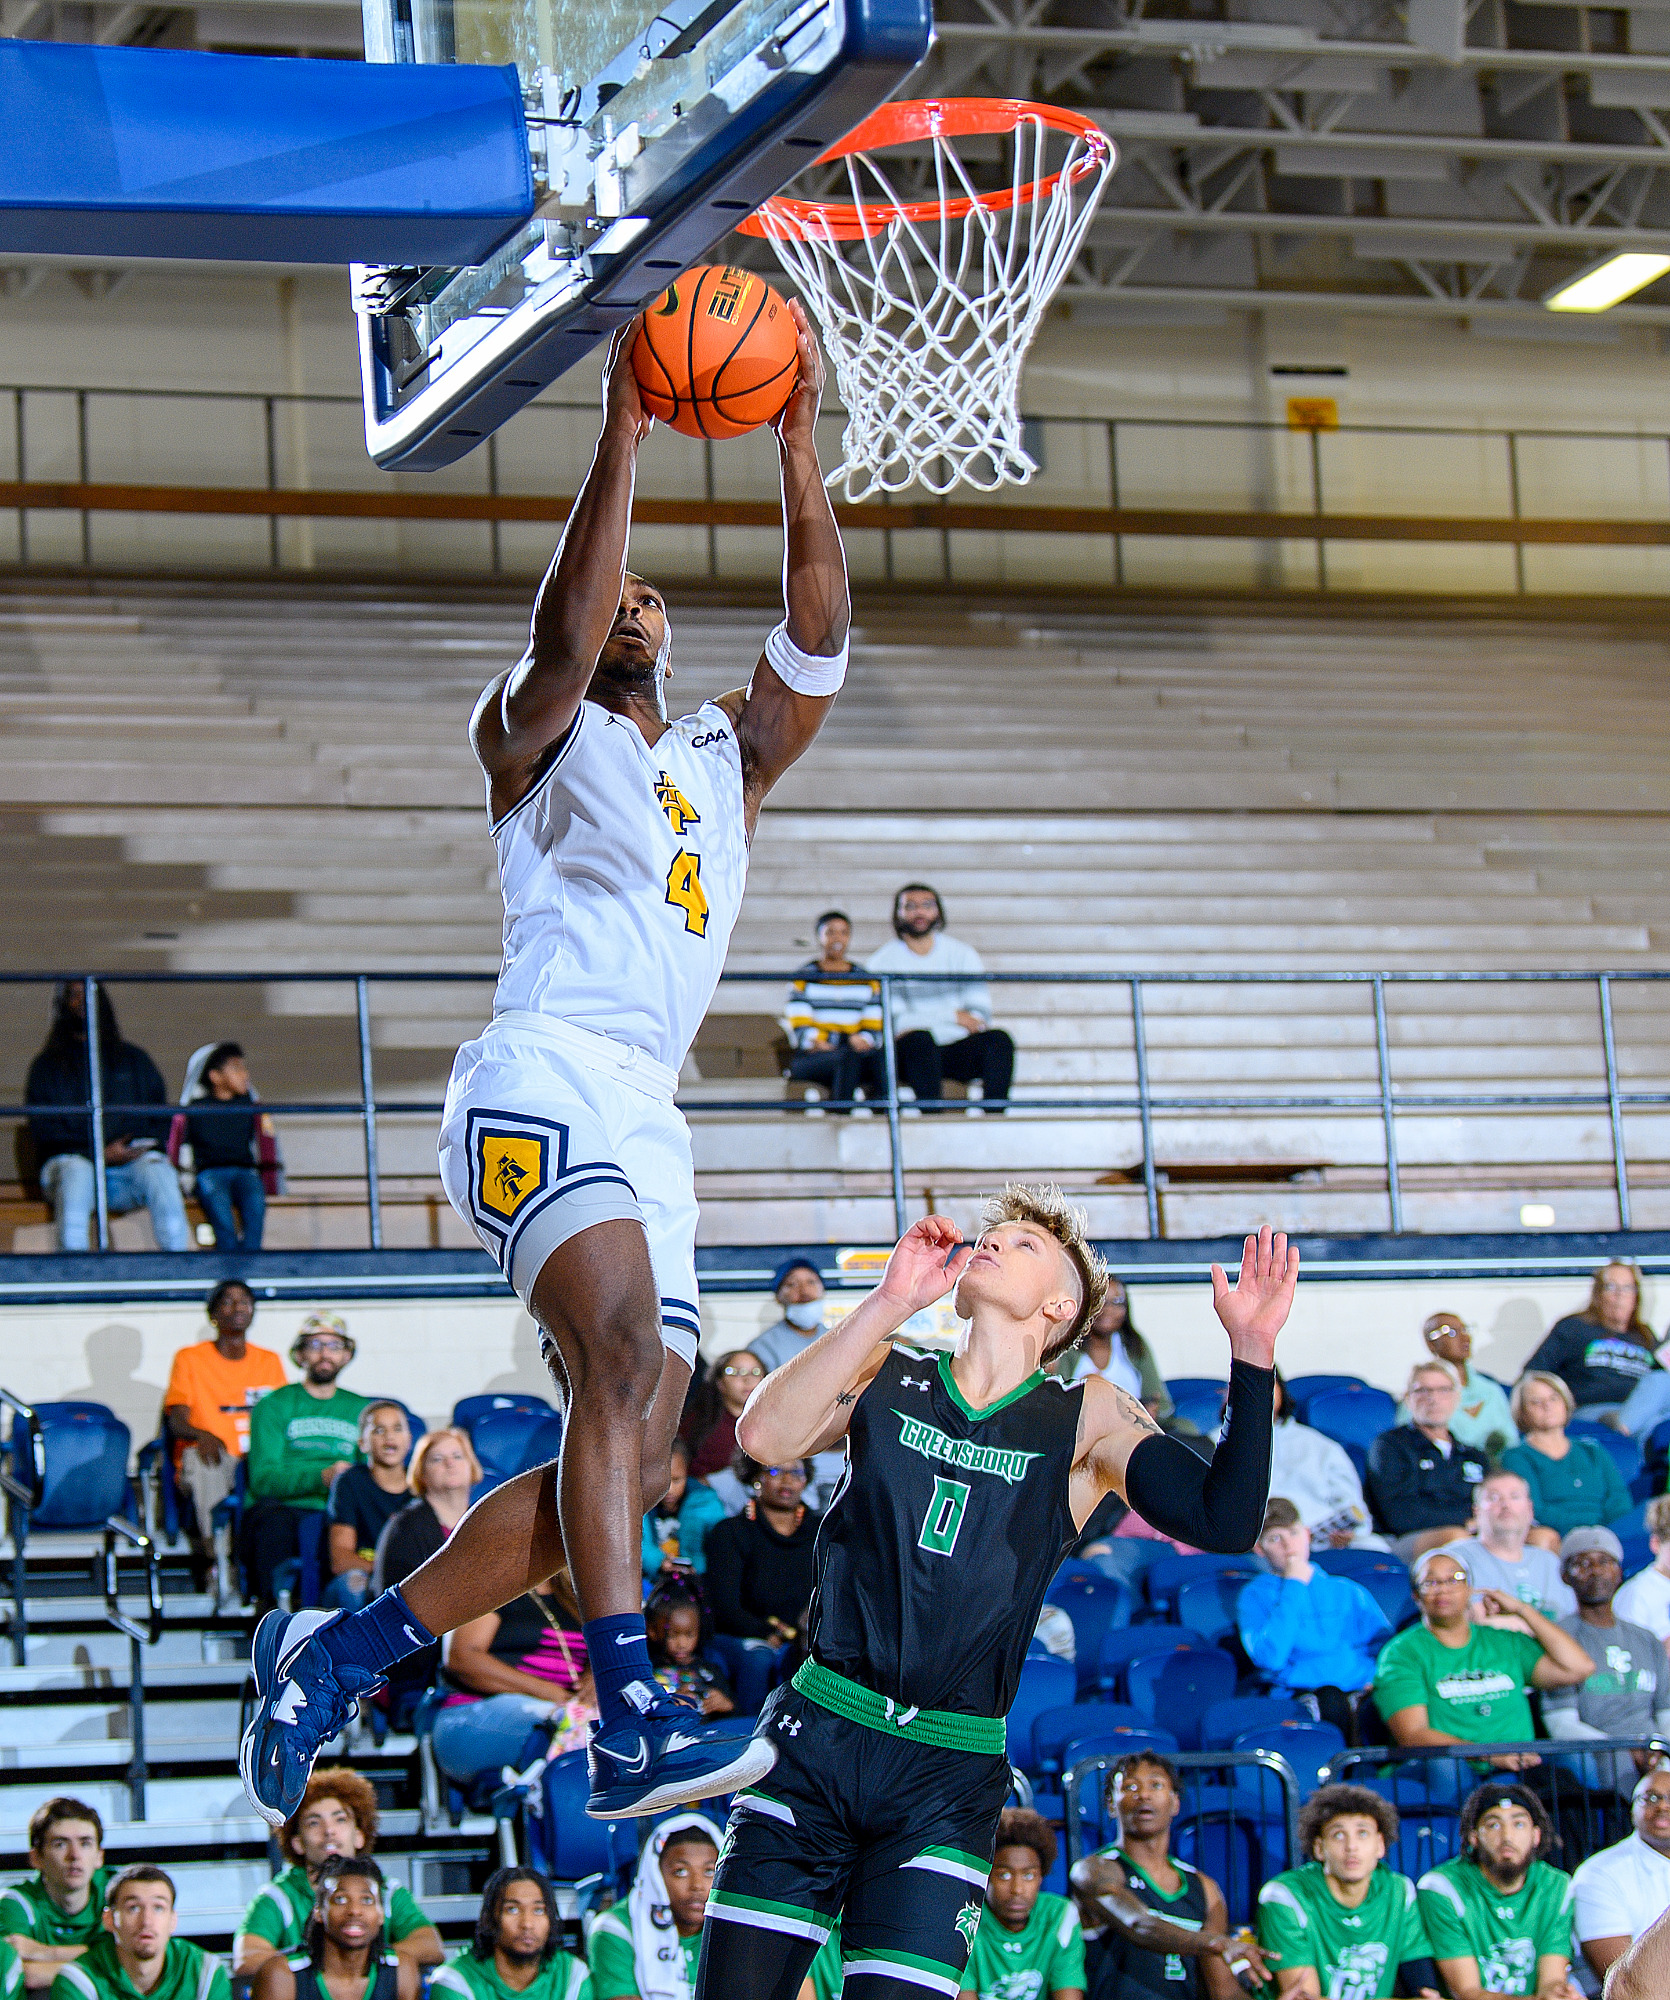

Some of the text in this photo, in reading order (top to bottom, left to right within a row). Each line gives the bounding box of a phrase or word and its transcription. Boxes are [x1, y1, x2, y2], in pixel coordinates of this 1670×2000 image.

[691, 728, 730, 749] CAA
[664, 846, 710, 939] 4
[889, 1408, 1046, 1486] GREENSBORO
[917, 1474, 972, 1558] 0
